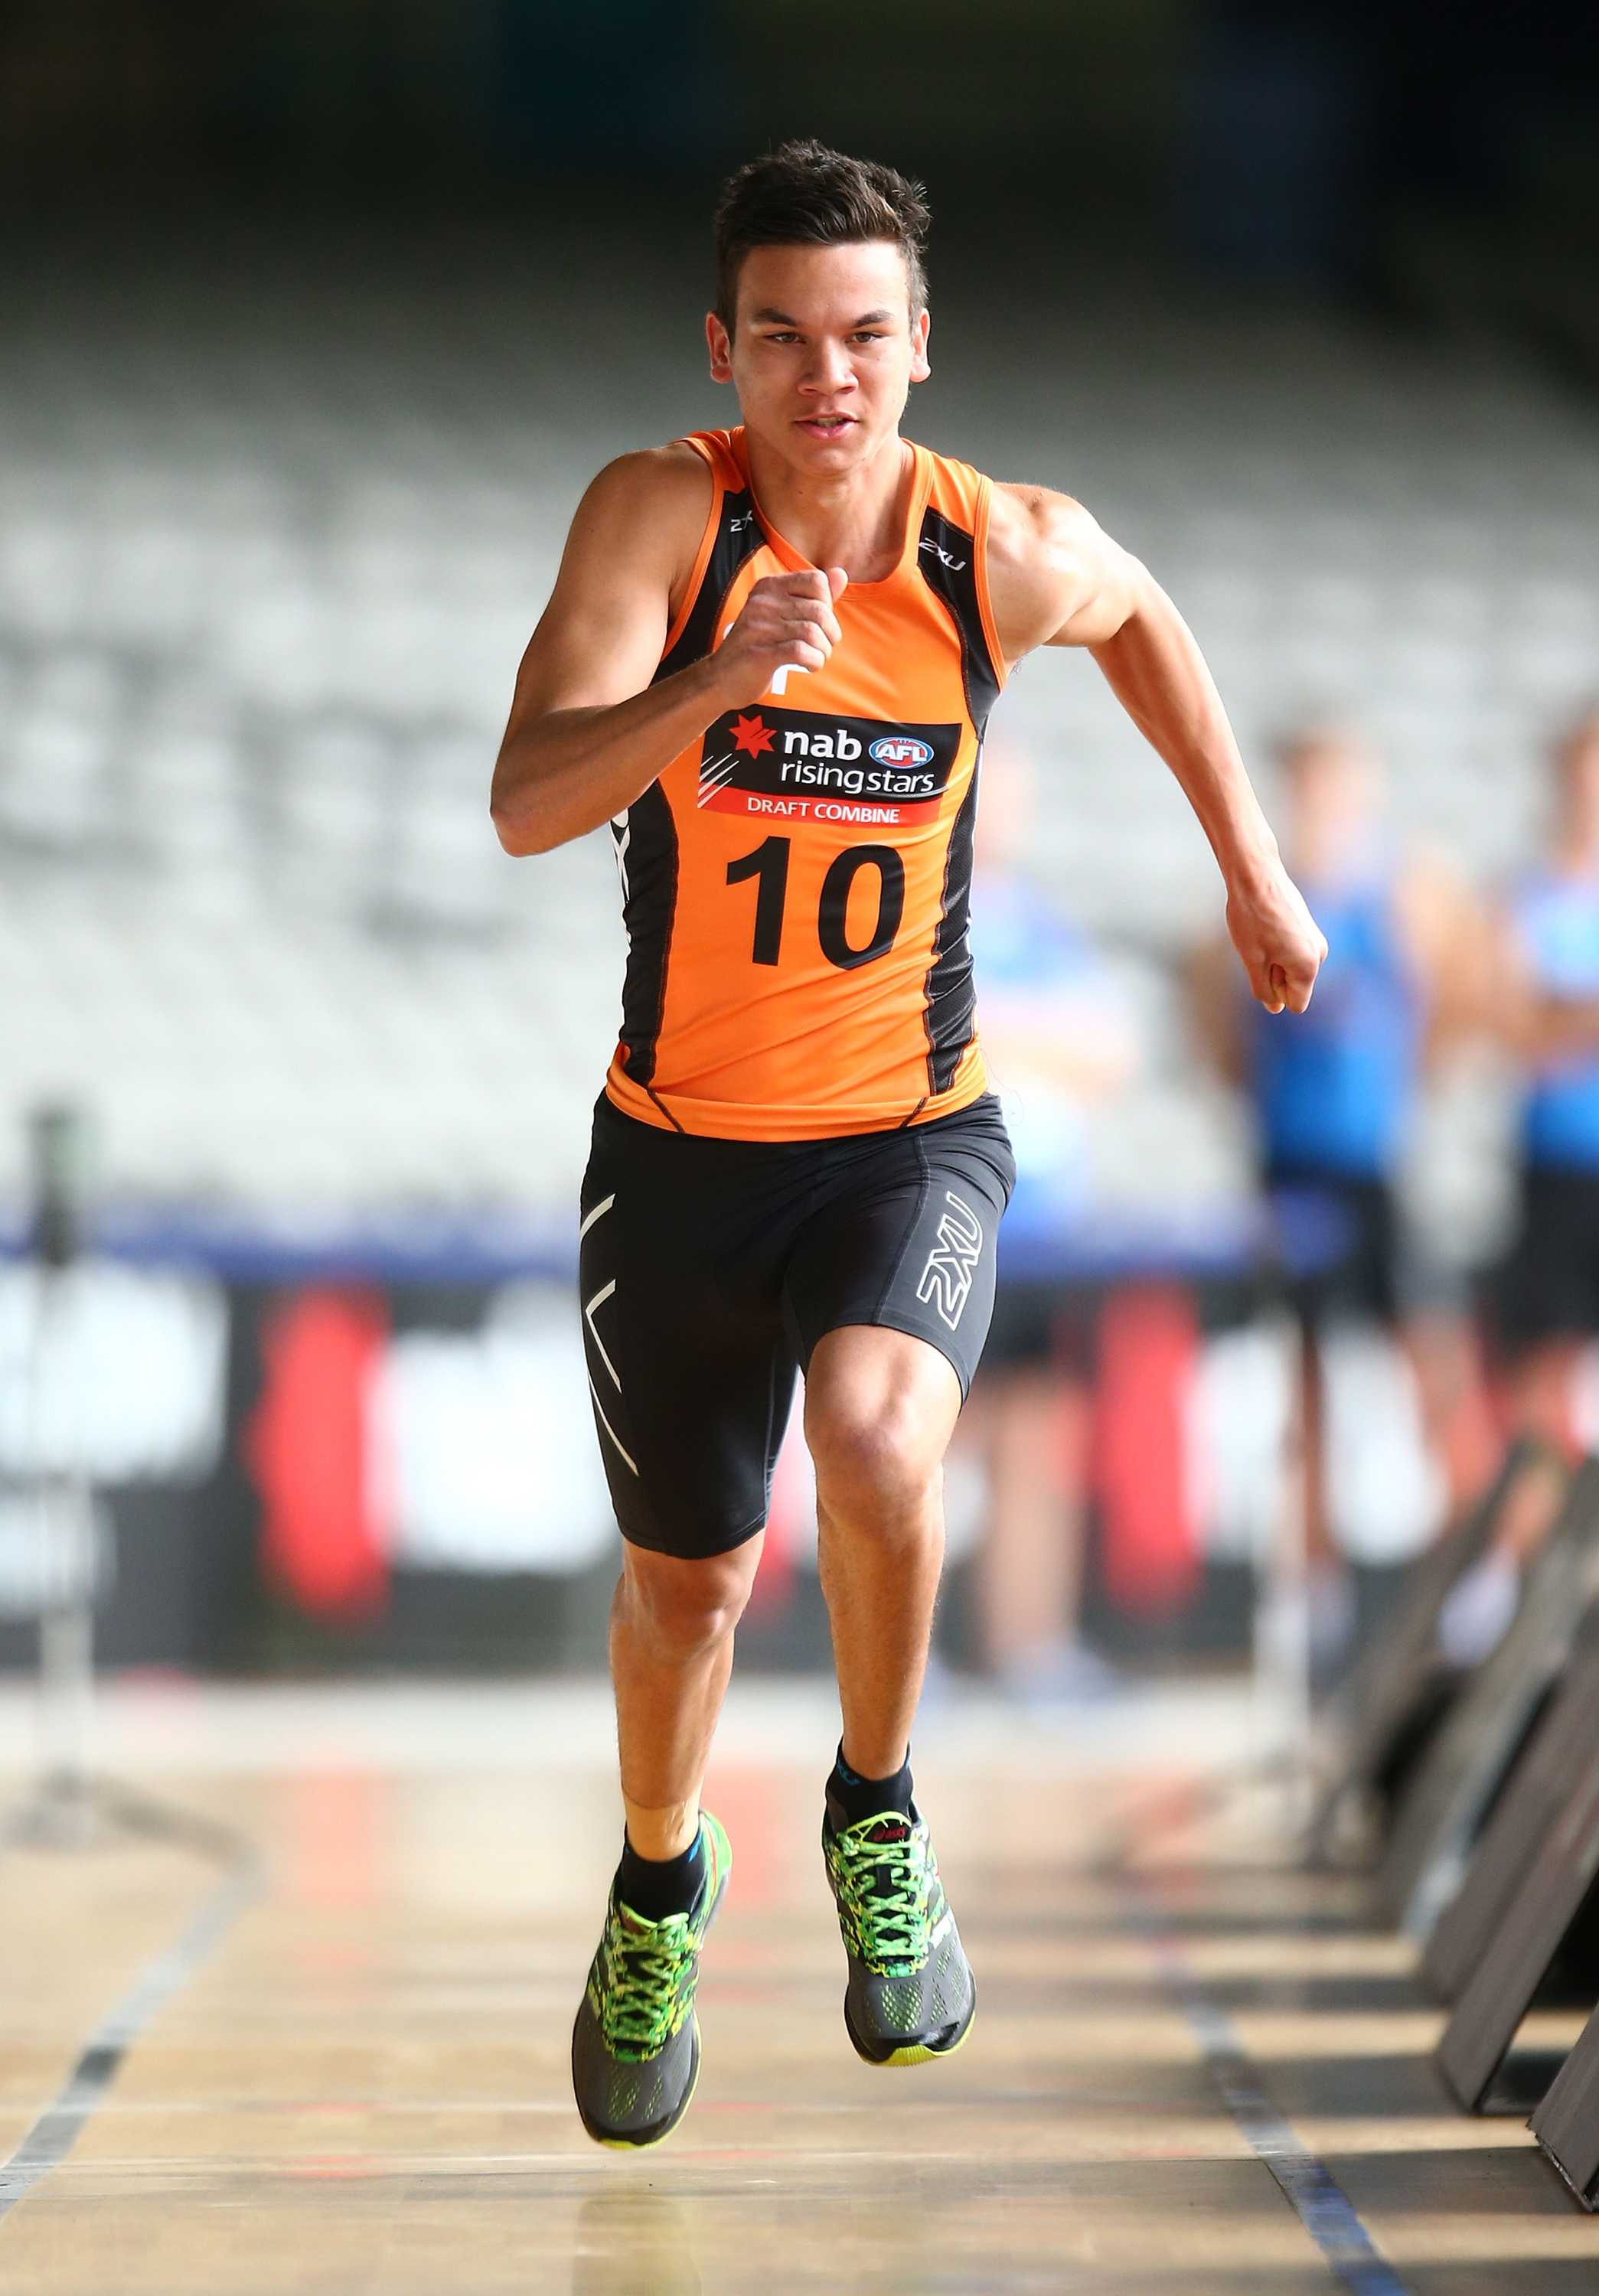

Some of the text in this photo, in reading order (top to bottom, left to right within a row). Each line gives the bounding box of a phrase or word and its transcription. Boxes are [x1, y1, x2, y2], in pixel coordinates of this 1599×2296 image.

[730, 510, 754, 533] 2X
[919, 537, 967, 571] 2XU
[784, 729, 929, 763] nab AFL
[747, 797, 901, 824] DRAFT COMBINE
[726, 836, 905, 970] 10
[916, 1191, 983, 1331] 2XU
